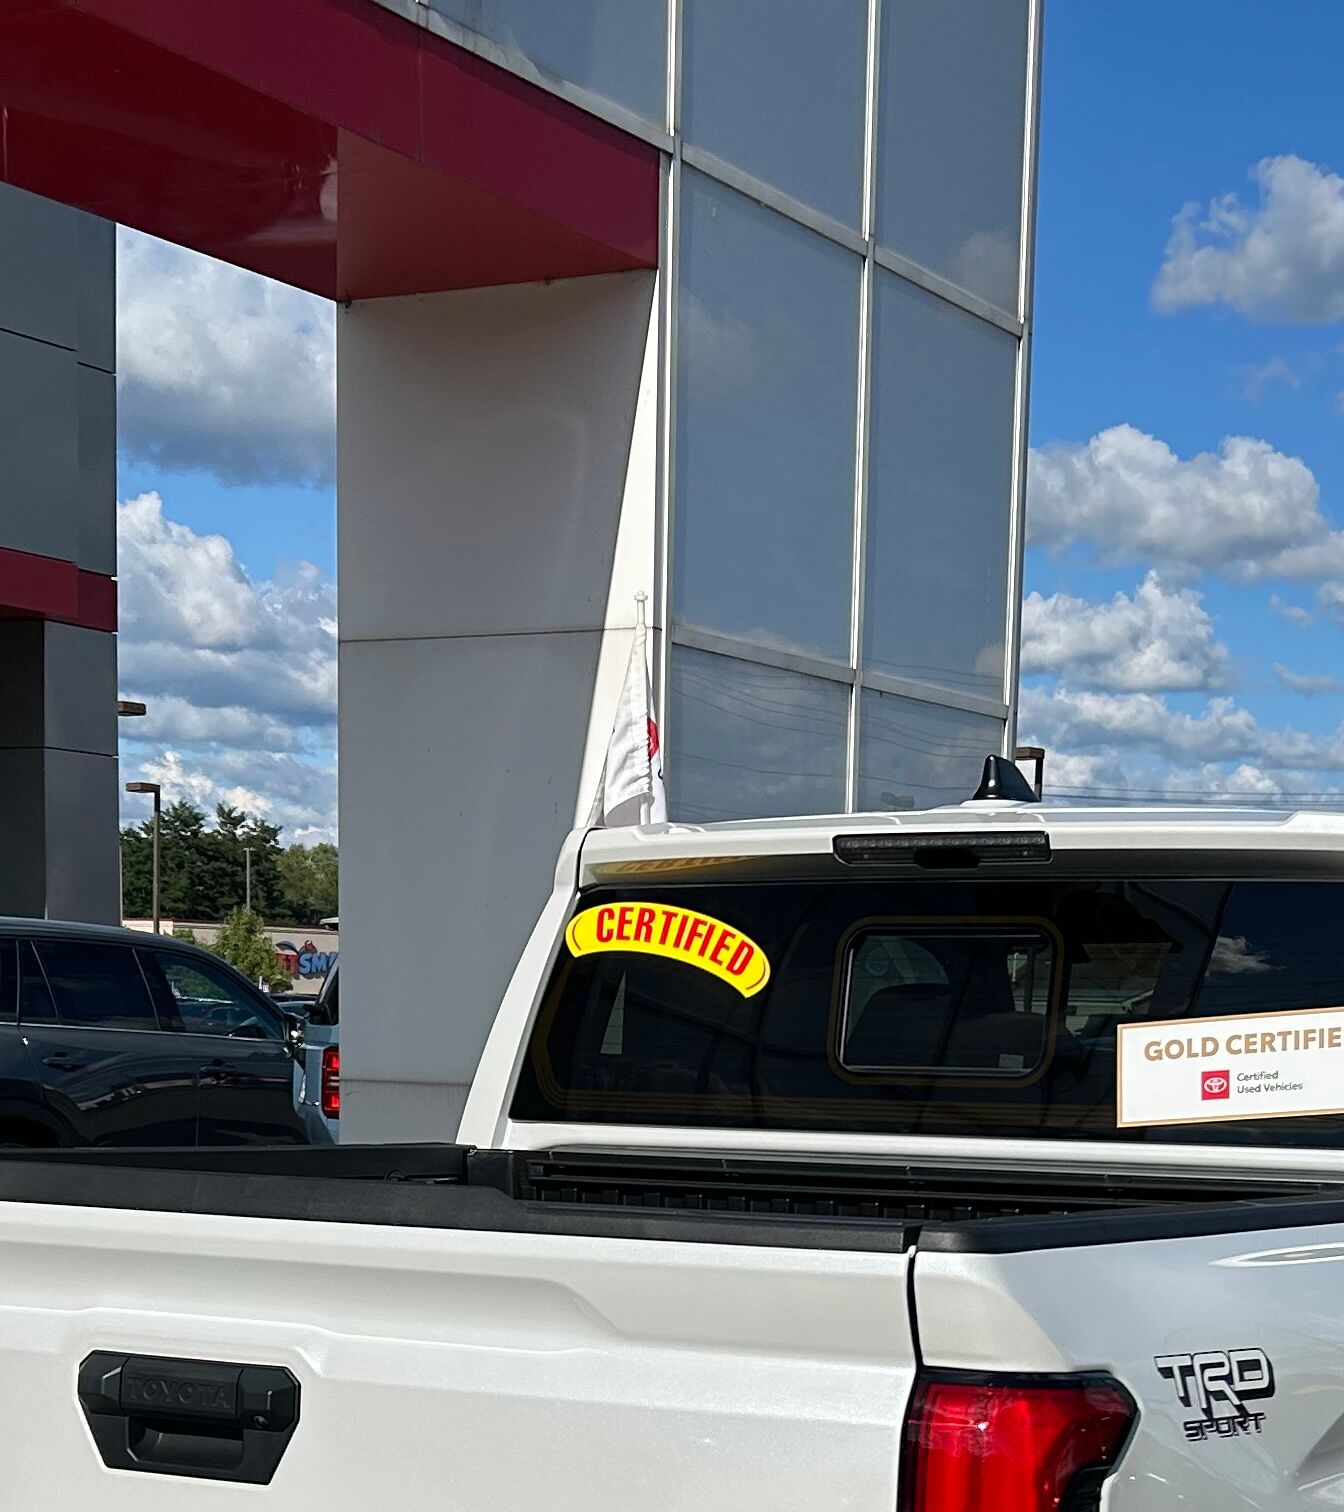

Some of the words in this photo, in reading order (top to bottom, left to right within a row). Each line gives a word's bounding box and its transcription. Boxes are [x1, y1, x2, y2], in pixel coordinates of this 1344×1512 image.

[596, 906, 755, 976] CERTIFIED
[1144, 1038, 1220, 1062] GOLD
[1236, 1070, 1279, 1082] Certified
[1236, 1083, 1262, 1094] Used
[1263, 1081, 1303, 1093] Vehicles
[126, 1375, 231, 1409] TOYOTA
[1154, 1347, 1275, 1416] TRD
[1183, 1412, 1267, 1441] SPORT
